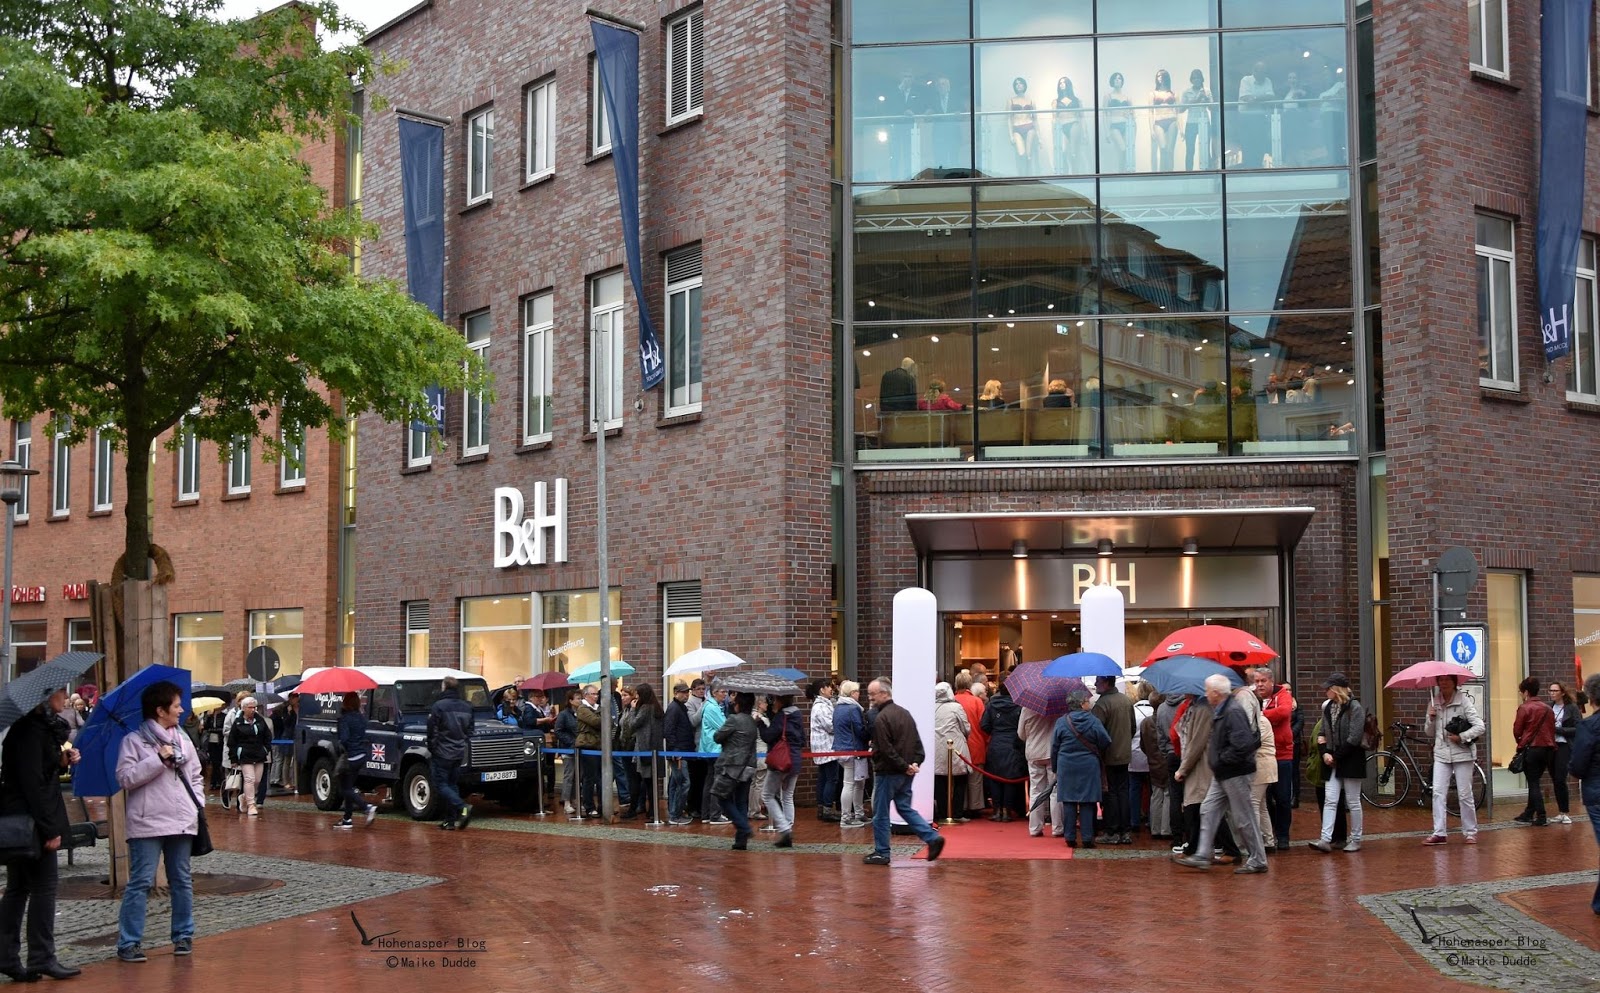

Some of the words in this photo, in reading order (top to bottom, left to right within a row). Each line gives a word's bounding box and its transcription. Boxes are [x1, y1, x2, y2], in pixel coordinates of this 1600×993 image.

[1540, 304, 1567, 345] &H
[493, 478, 568, 568] B&H
[0, 585, 45, 602] CHER
[1073, 562, 1136, 605] BH
[547, 638, 585, 657] Neueröffnung
[380, 763, 391, 771] TEAM
